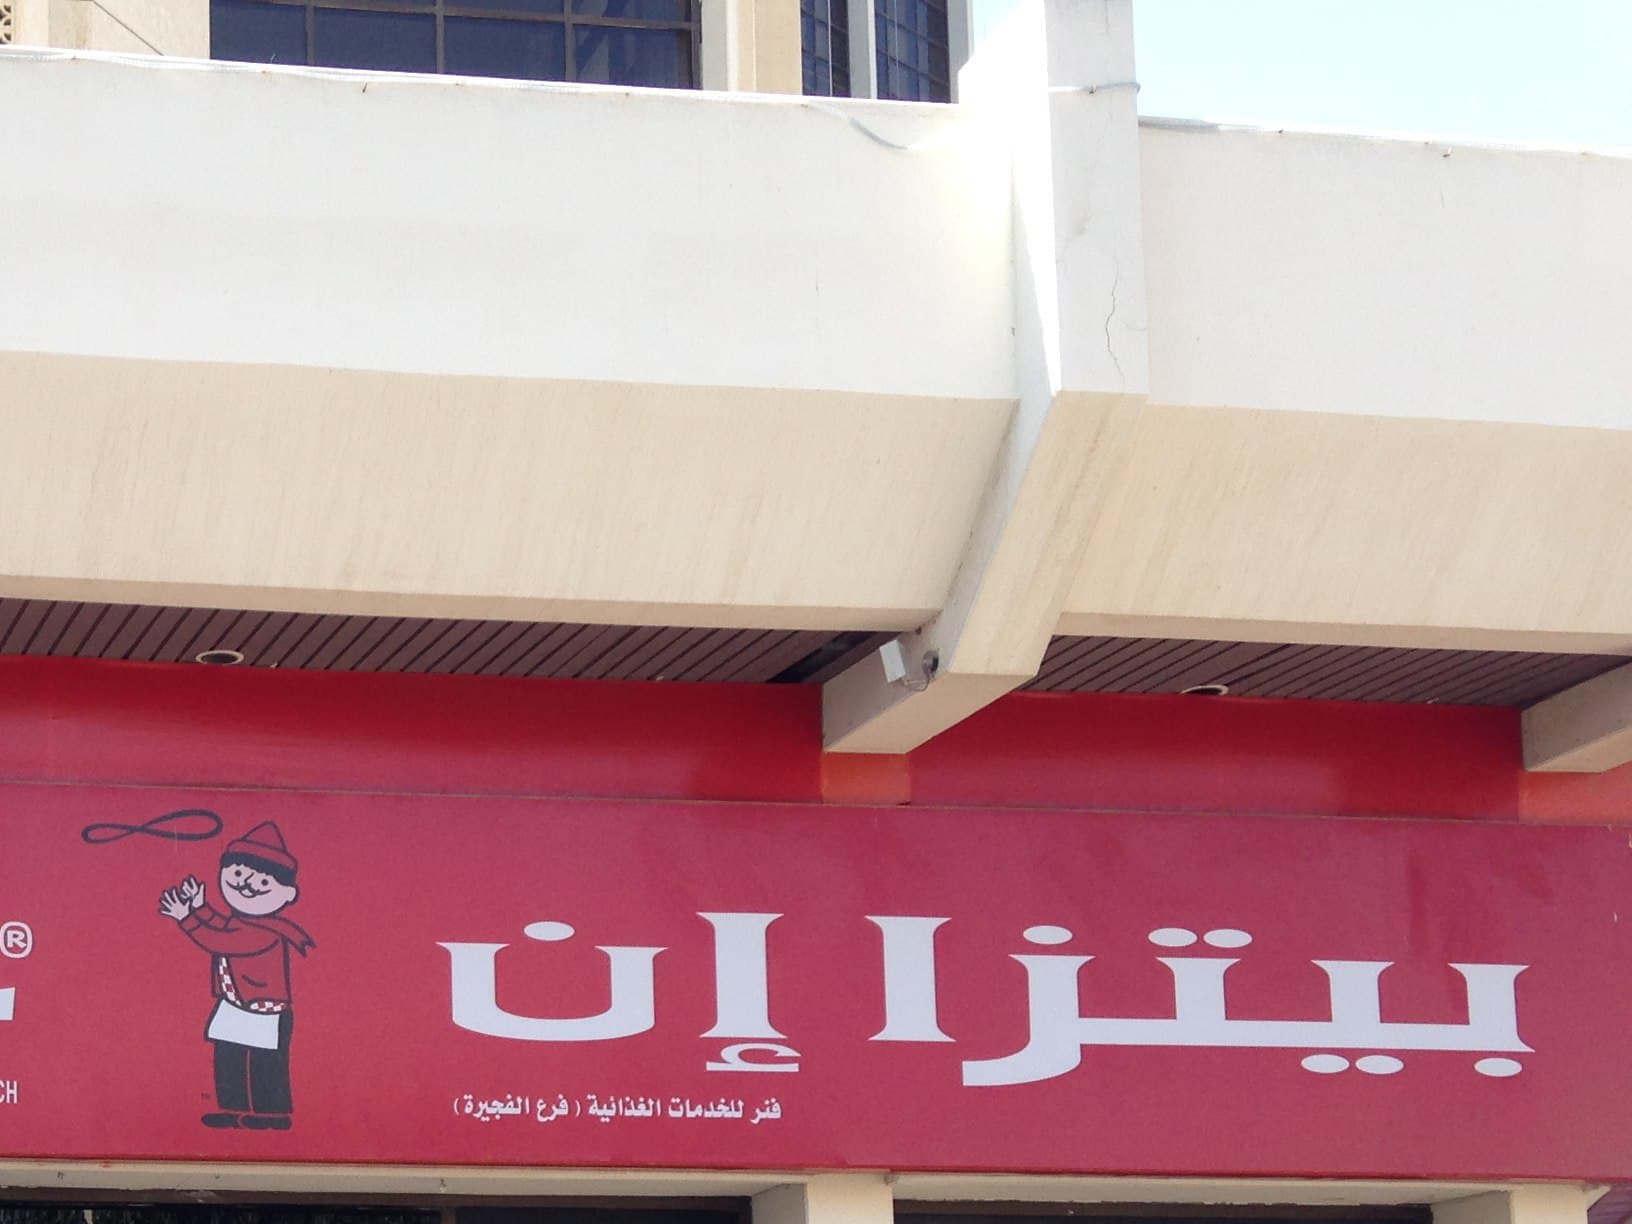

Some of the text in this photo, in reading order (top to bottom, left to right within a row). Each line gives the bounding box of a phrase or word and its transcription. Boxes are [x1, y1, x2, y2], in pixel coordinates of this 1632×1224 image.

[437, 911, 1535, 1087] بيتزا إن
[587, 1094, 662, 1124] الغذائية
[667, 1097, 745, 1119] للخدمات
[750, 1097, 783, 1124] فنر
